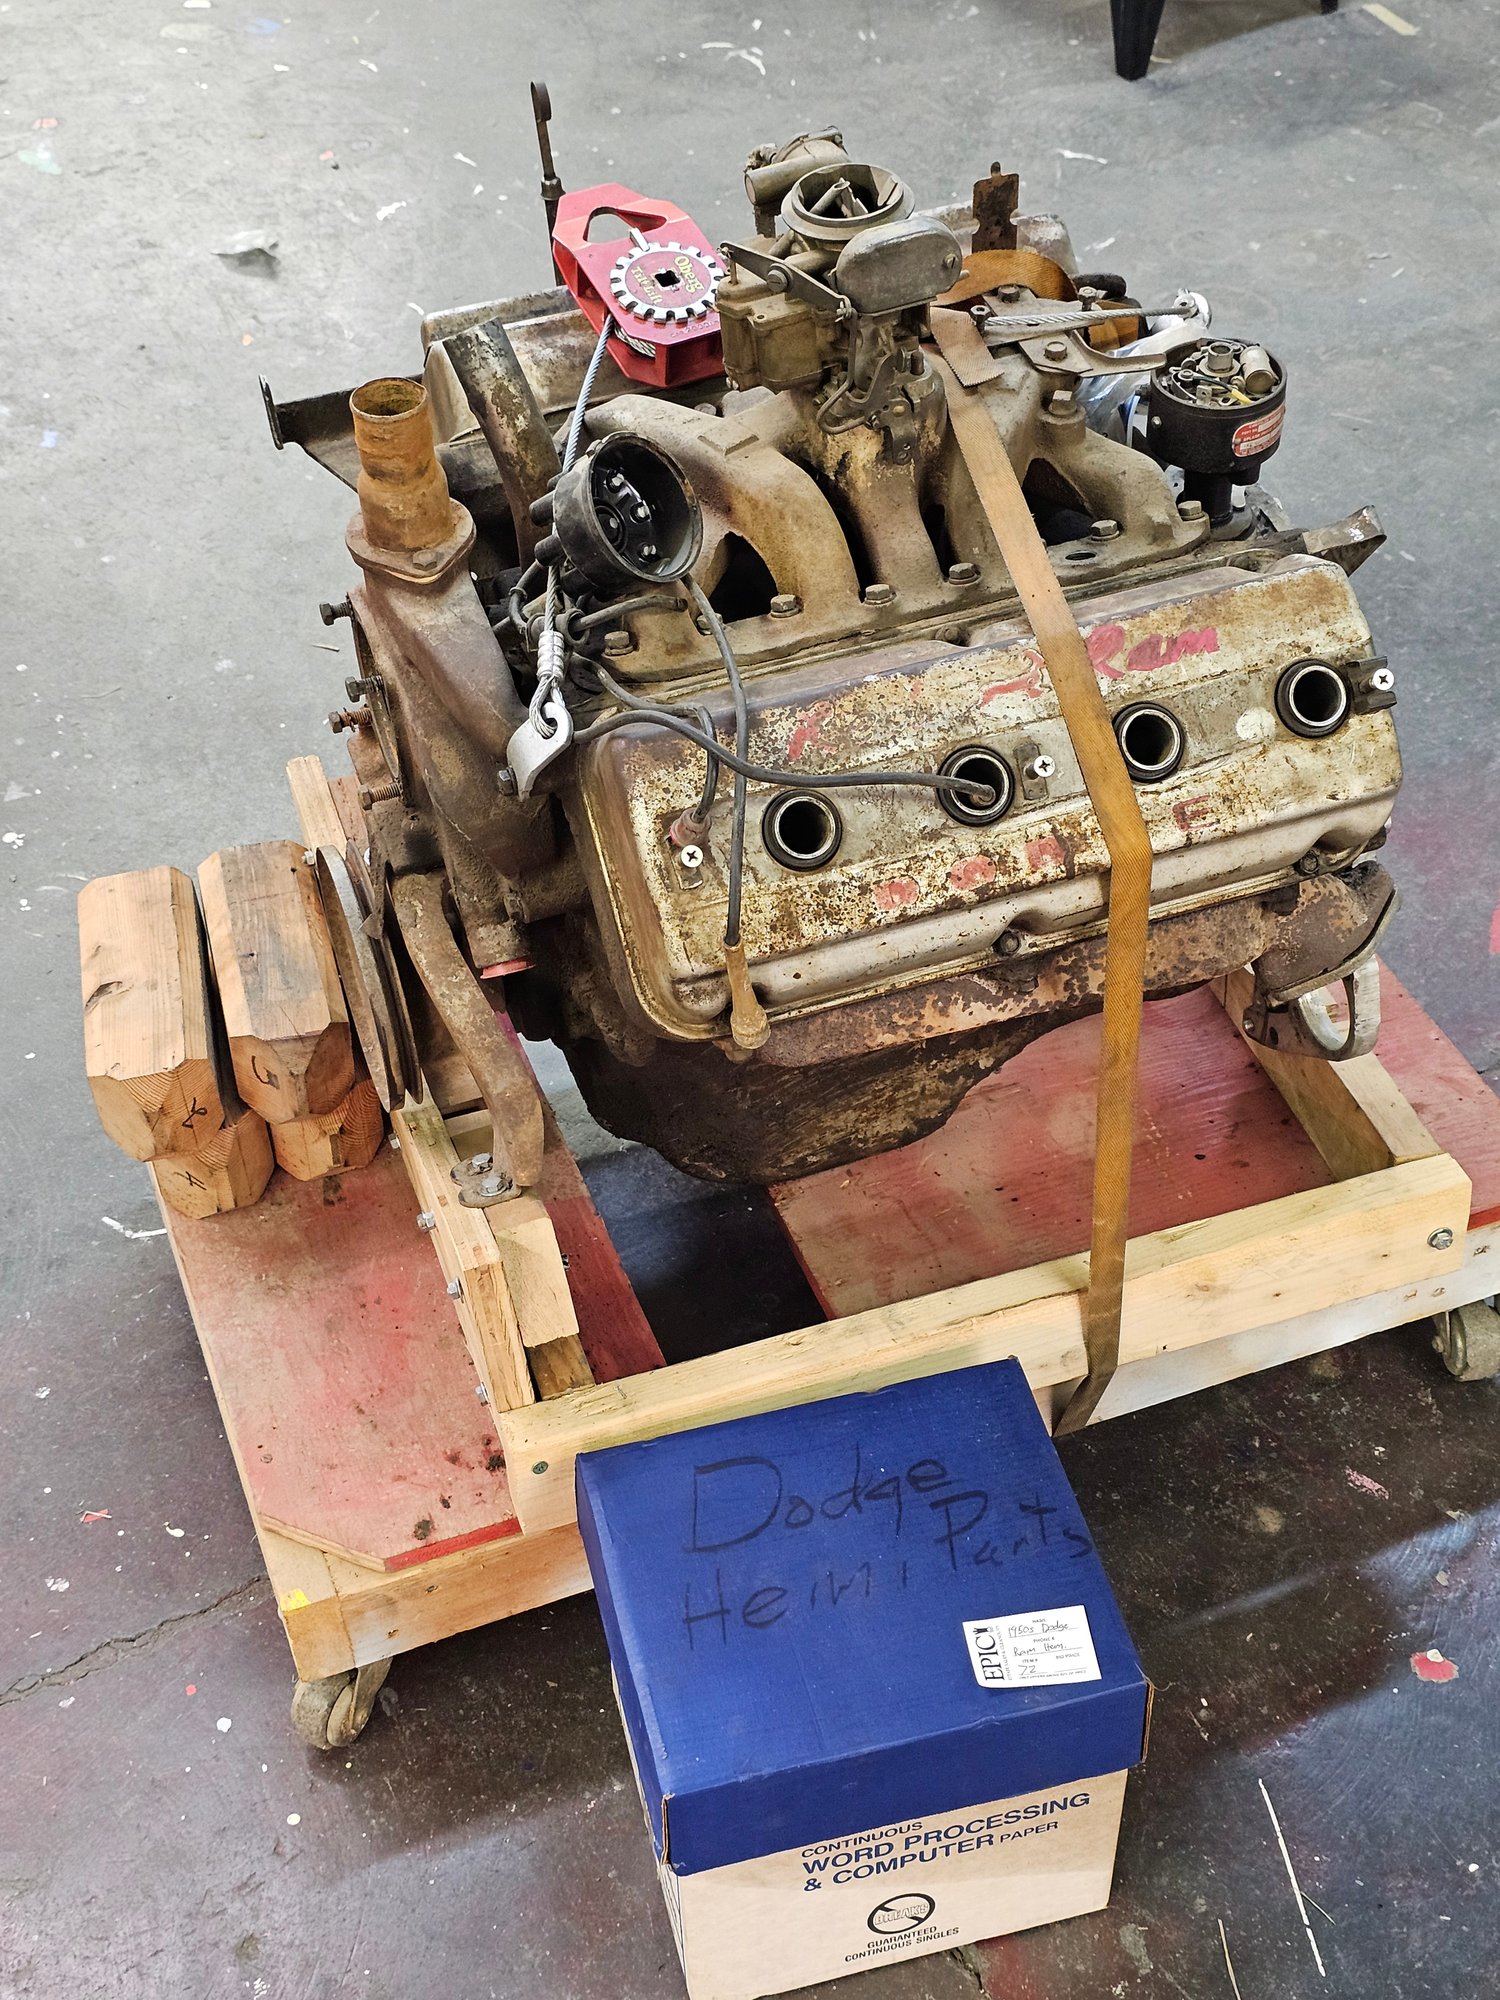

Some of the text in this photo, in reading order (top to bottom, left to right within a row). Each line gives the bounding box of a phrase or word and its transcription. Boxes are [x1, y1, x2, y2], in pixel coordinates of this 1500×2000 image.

[674, 255, 705, 293] Oberg
[1085, 624, 1220, 679] Ram
[685, 1441, 952, 1554] Dodge
[930, 1490, 1092, 1572] Parts
[1008, 1625, 1034, 1638] 1950s
[1041, 1619, 1070, 1634] Dodge
[975, 1634, 1006, 1681] EPIC
[1018, 1664, 1037, 1676] 72
[801, 1821, 924, 1859] CONTINUOUS
[802, 1792, 1091, 1875] WORD PROCESSING
[803, 1821, 1060, 1893] & COMPUTER PAPER
[874, 1903, 929, 1926] BREAKS
[845, 1926, 961, 1963] CONTINUOUS SINGLES
[867, 1926, 937, 1950] GUARANTEED
